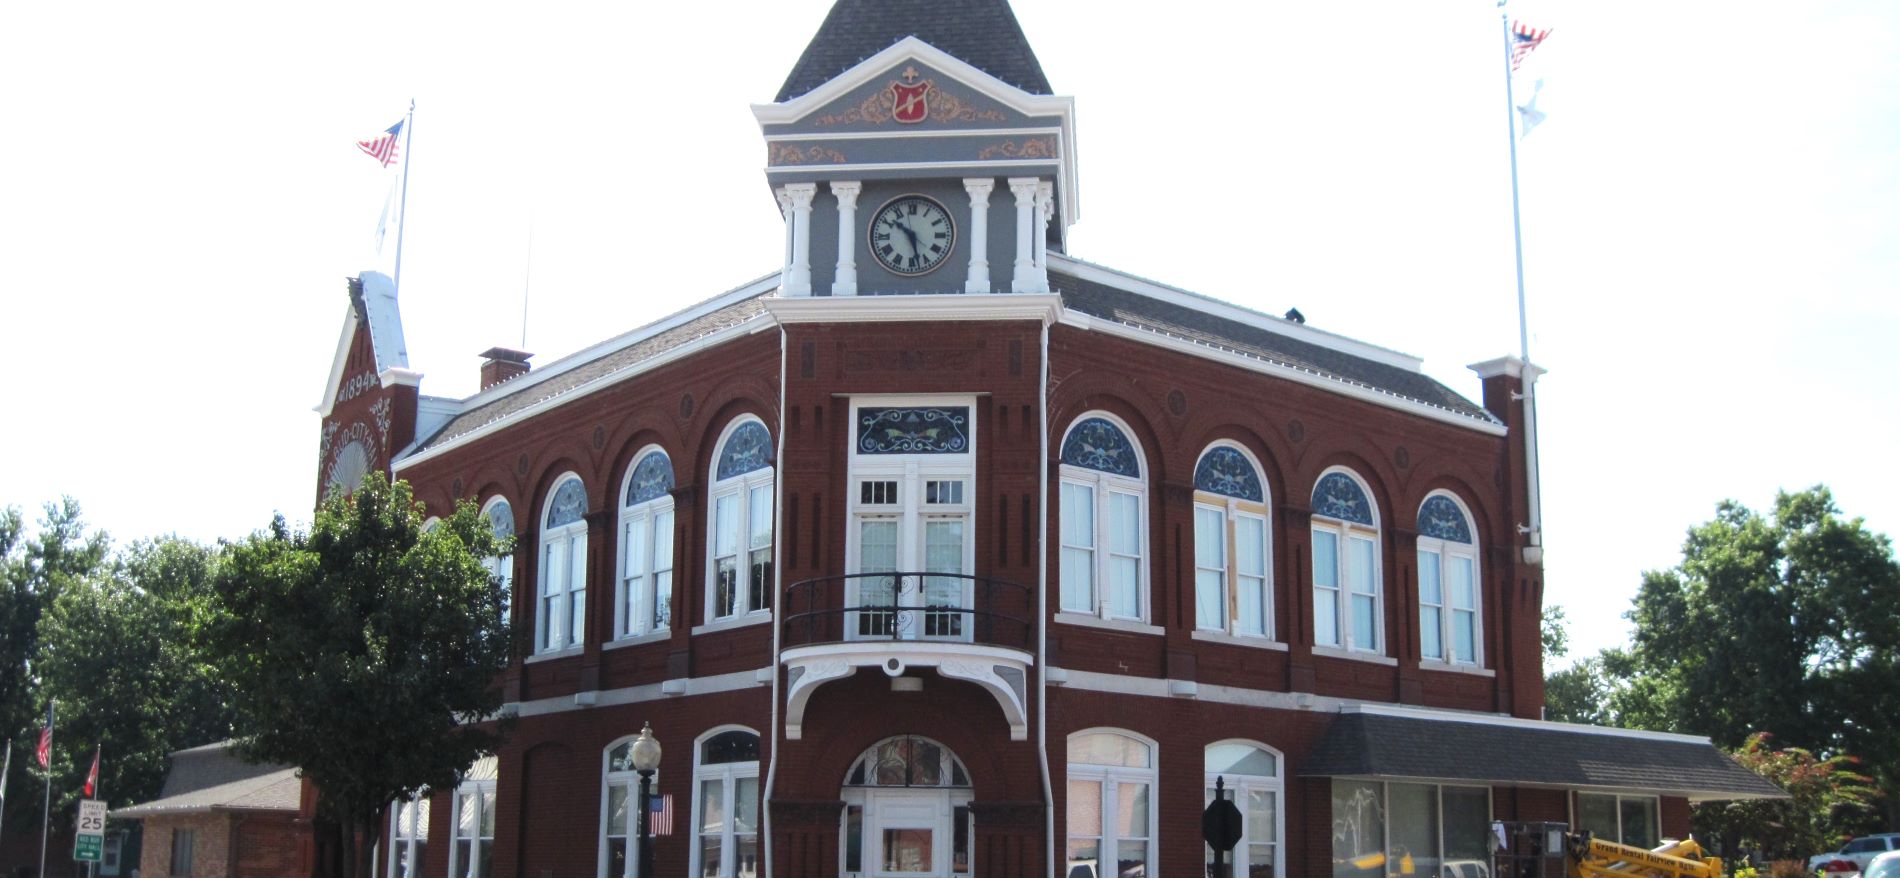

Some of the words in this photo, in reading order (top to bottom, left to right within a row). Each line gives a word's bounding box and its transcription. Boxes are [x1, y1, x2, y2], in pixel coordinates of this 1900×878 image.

[345, 371, 370, 401] 1894
[352, 422, 370, 442] CITY
[81, 817, 102, 830] 25
[1596, 843, 1618, 854] Grand
[1621, 849, 1644, 860] Rental
[1647, 854, 1675, 867] Fairview
